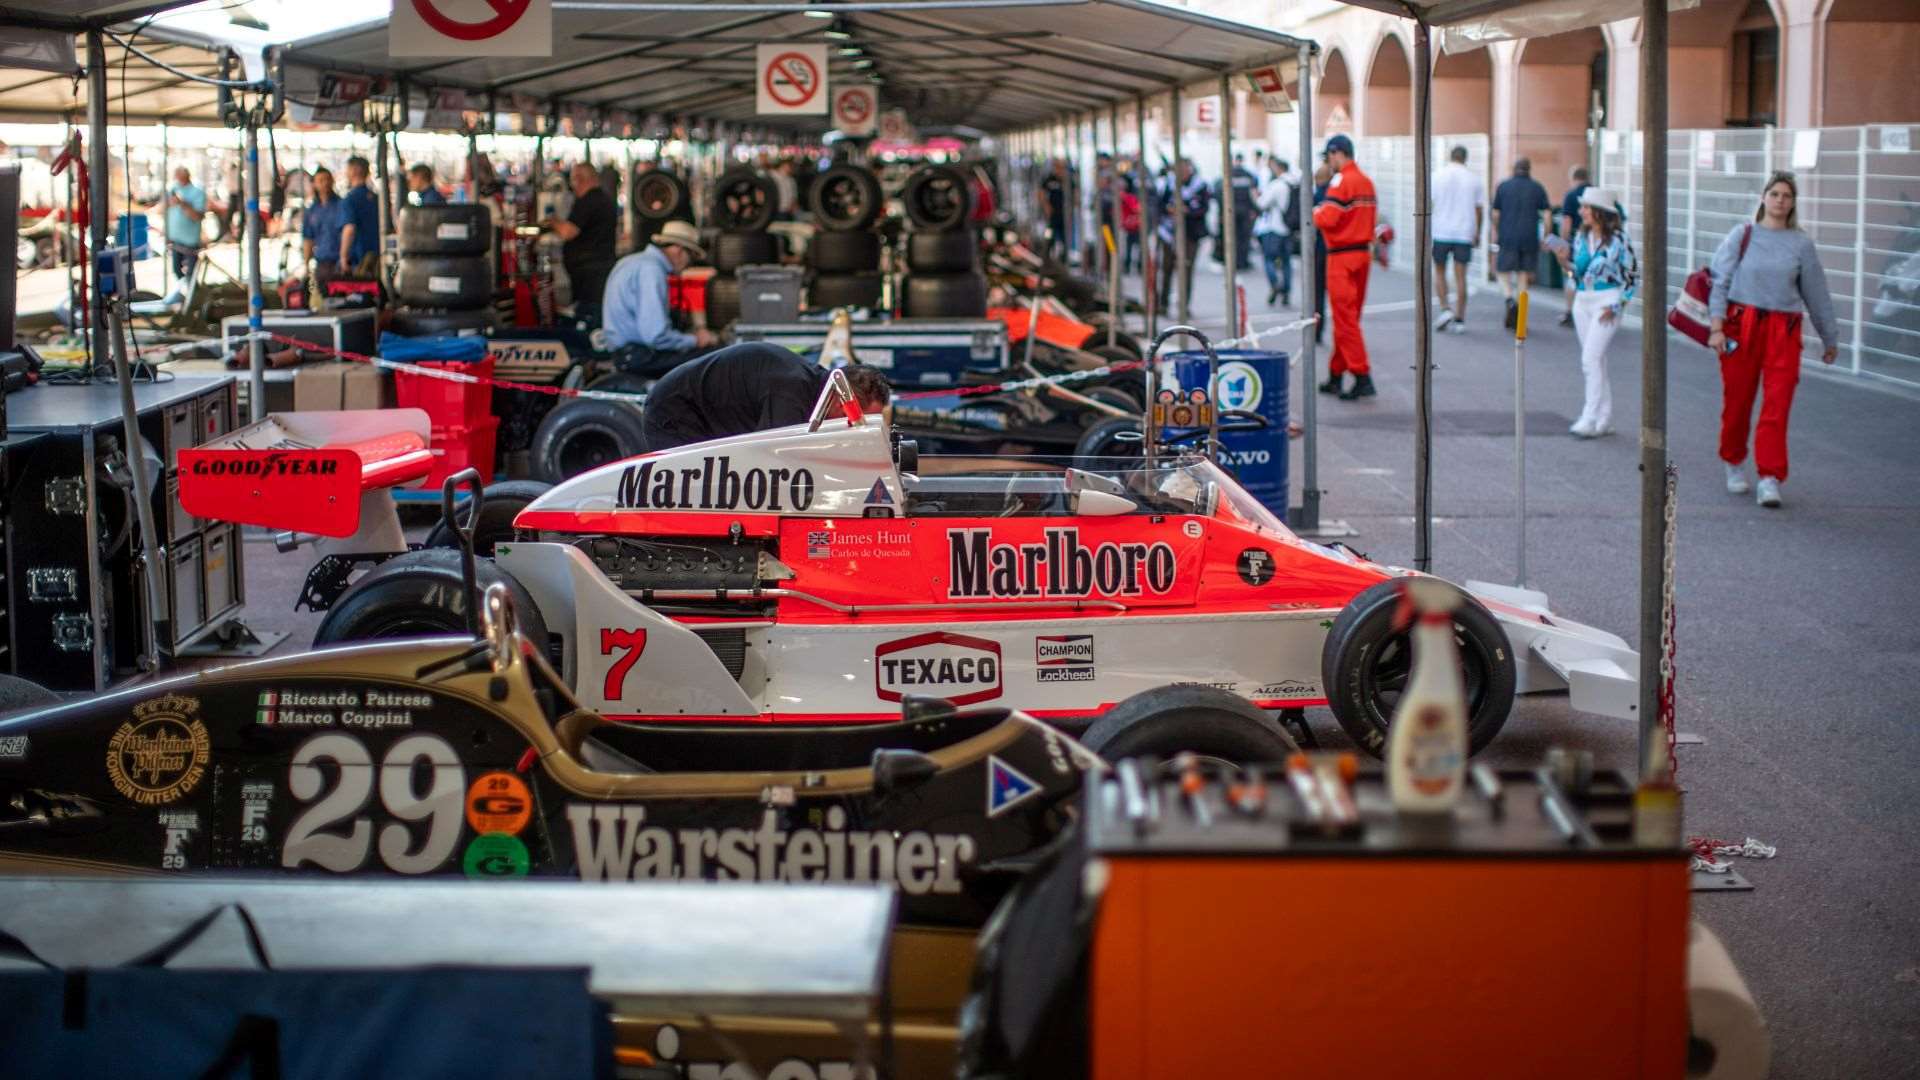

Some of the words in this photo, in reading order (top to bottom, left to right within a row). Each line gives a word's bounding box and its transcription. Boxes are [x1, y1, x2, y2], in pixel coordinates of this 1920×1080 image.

[493, 348, 556, 361] DYEAR
[192, 455, 338, 477] GOODYEAR
[1217, 450, 1271, 466] OLVO
[615, 456, 815, 511] Marlboro
[1187, 523, 1198, 535] E
[831, 531, 873, 545] James
[877, 531, 912, 544] Hunt
[831, 549, 859, 558] Carlos
[861, 548, 871, 557] de
[873, 548, 910, 558] Quesada
[947, 526, 1177, 599] Marlboro
[1038, 644, 1091, 656] CHAMPION
[600, 627, 647, 701] 7
[882, 656, 996, 685] TEXACO
[1037, 668, 1094, 681] Lockheed
[1252, 686, 1317, 695] ALEGRA
[279, 692, 358, 706] Riccardo
[365, 692, 433, 706] Patrese
[277, 710, 333, 724] Marco
[341, 710, 413, 727] Coppini
[136, 787, 182, 804] UNTER
[180, 766, 204, 793] DEN
[487, 778, 509, 790] 29
[282, 734, 466, 875] 29
[473, 796, 525, 816] G
[164, 829, 188, 854] F
[242, 826, 265, 841] 29
[566, 804, 976, 895] Warsteiner
[162, 856, 186, 869] 29
